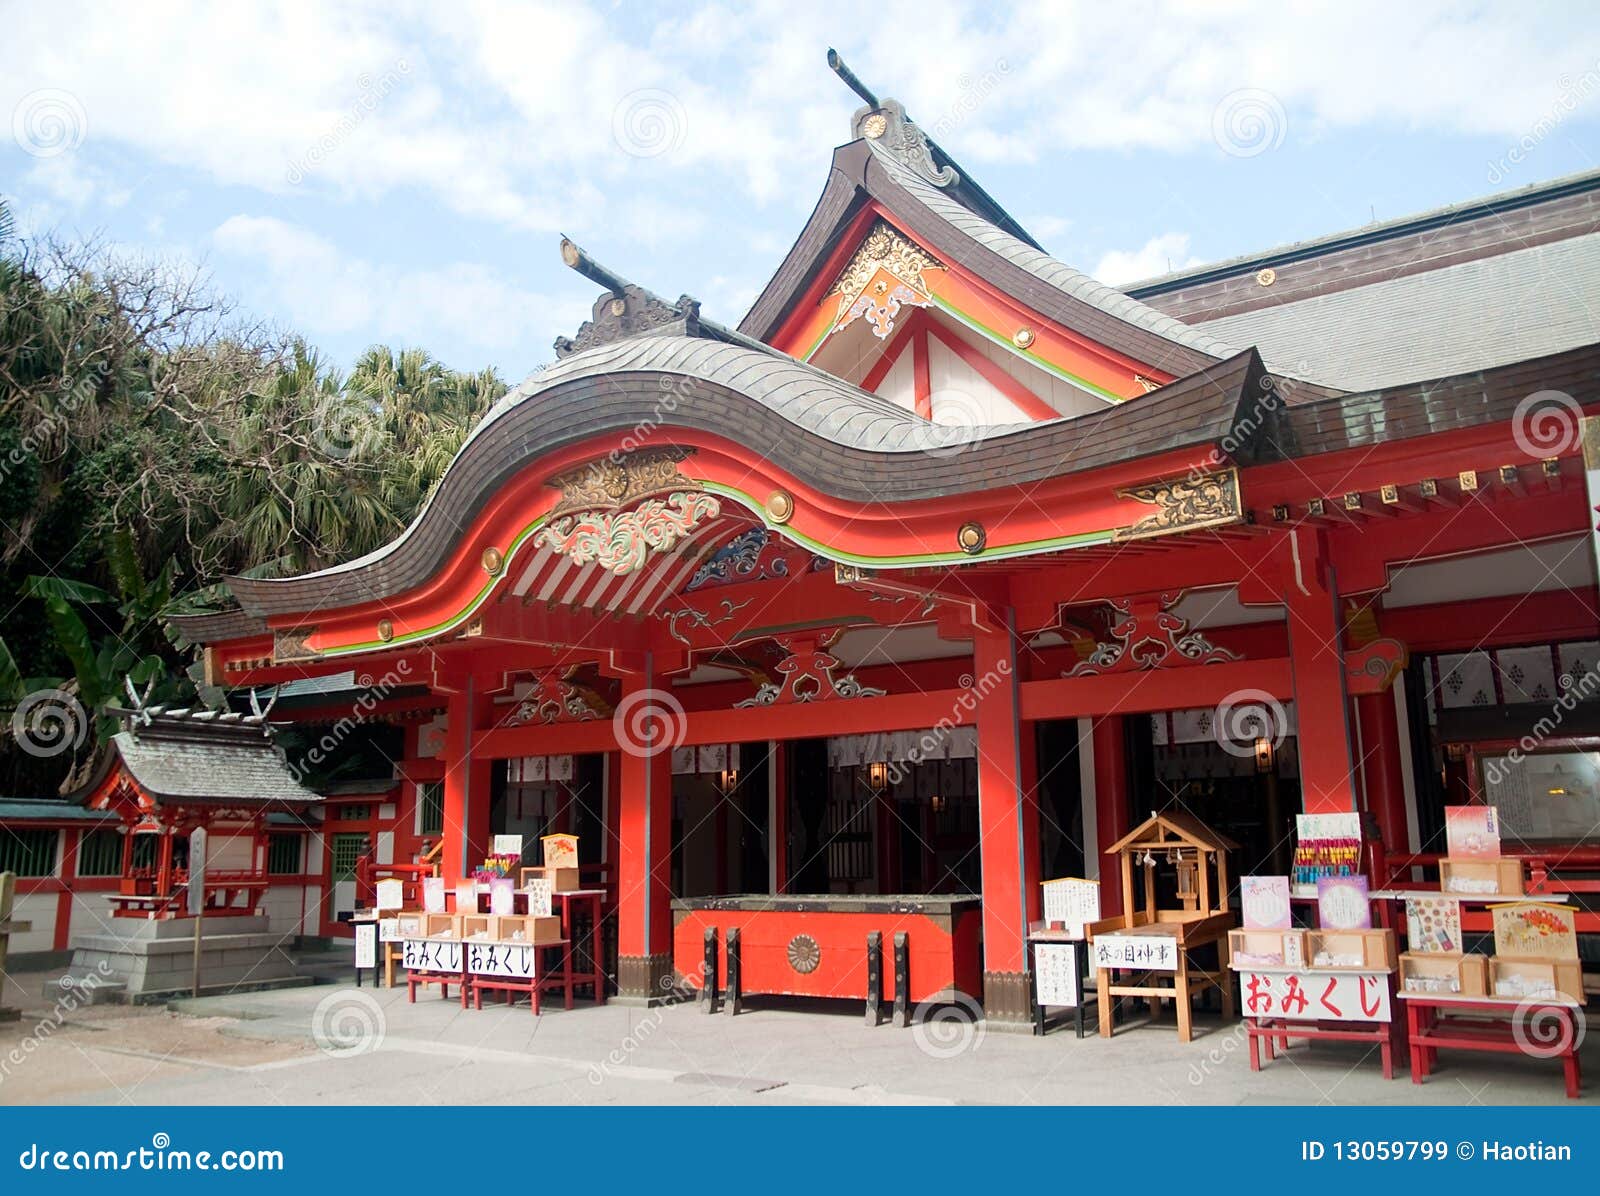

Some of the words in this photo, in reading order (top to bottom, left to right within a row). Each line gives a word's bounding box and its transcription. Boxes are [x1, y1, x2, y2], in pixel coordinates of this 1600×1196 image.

[405, 940, 460, 970] おみくじ
[471, 944, 531, 975] おみくじ
[1246, 973, 1381, 1018] おみくじ
